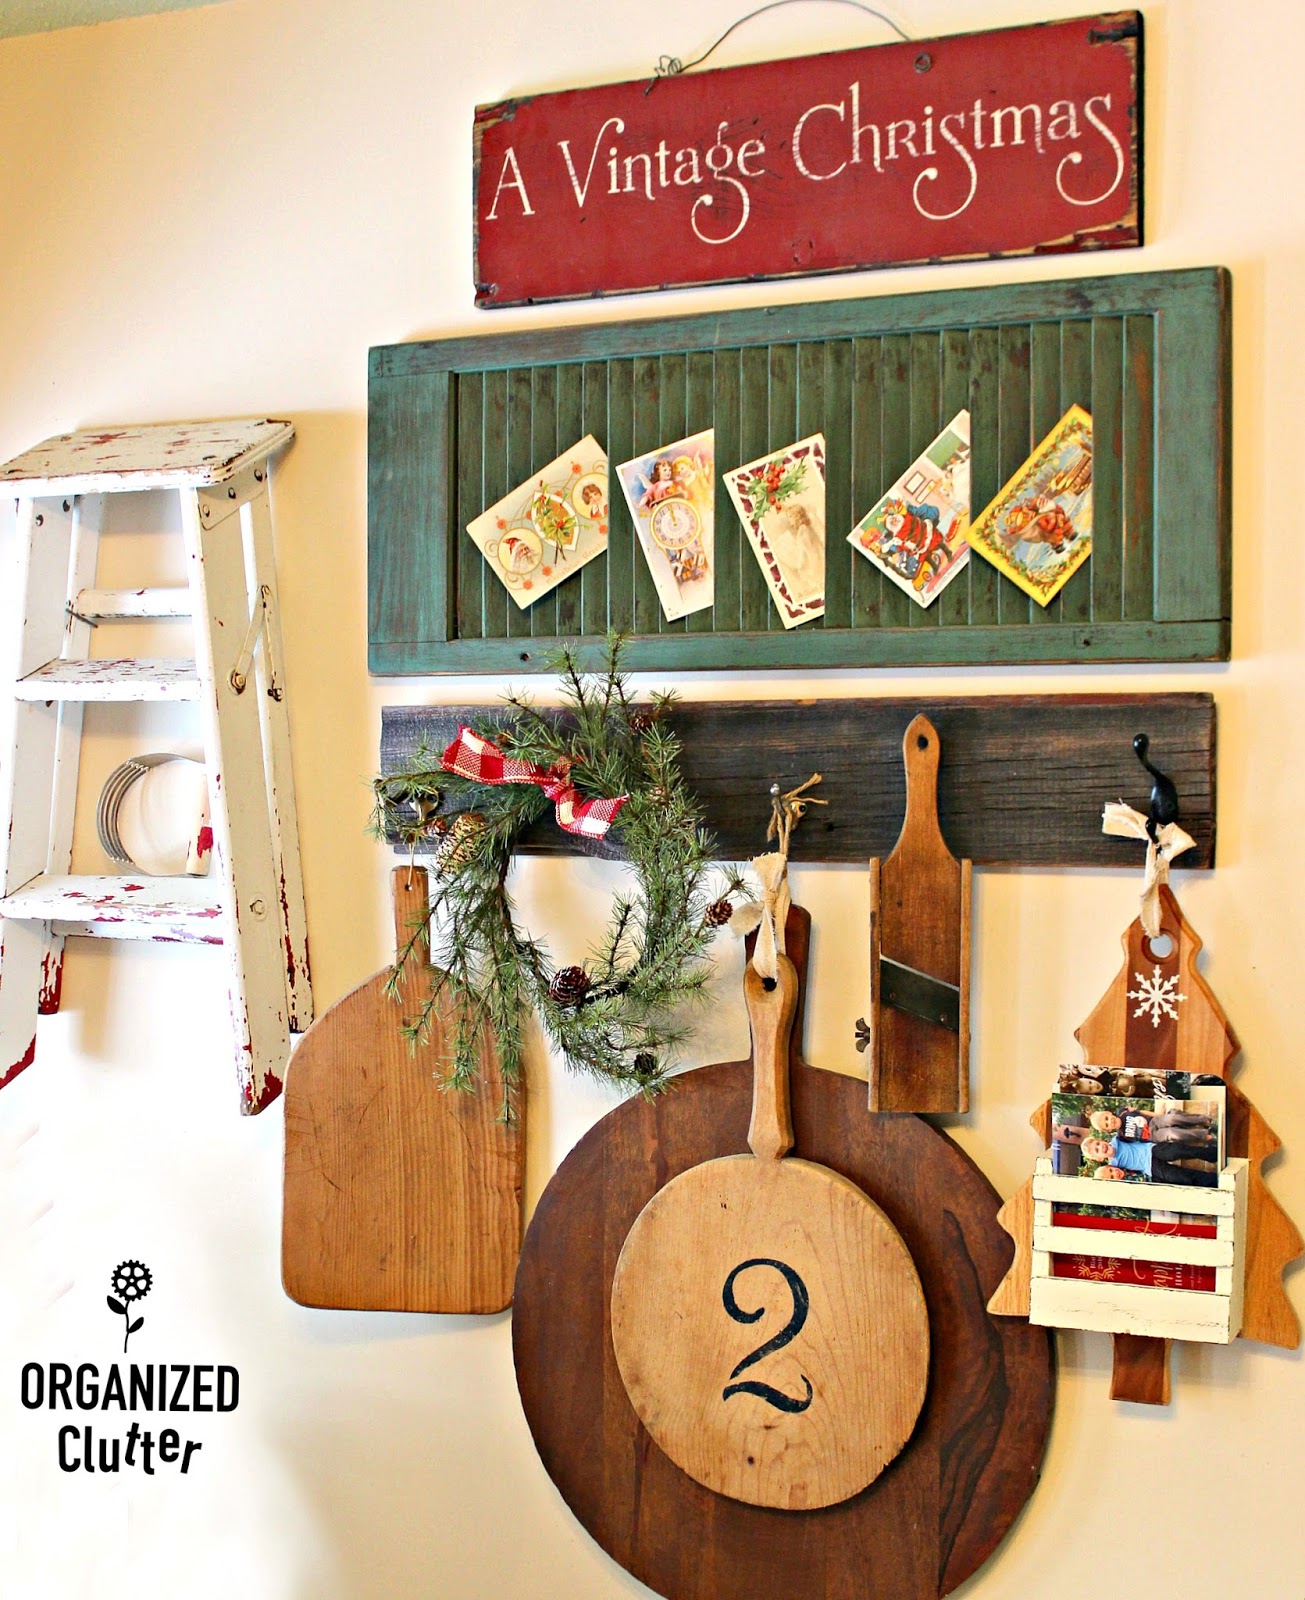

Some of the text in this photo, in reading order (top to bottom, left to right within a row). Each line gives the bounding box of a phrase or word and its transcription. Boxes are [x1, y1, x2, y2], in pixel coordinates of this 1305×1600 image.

[486, 81, 1125, 245] A Vintage Christmas
[1124, 1115, 1137, 1138] BRING
[722, 1258, 813, 1413] 2
